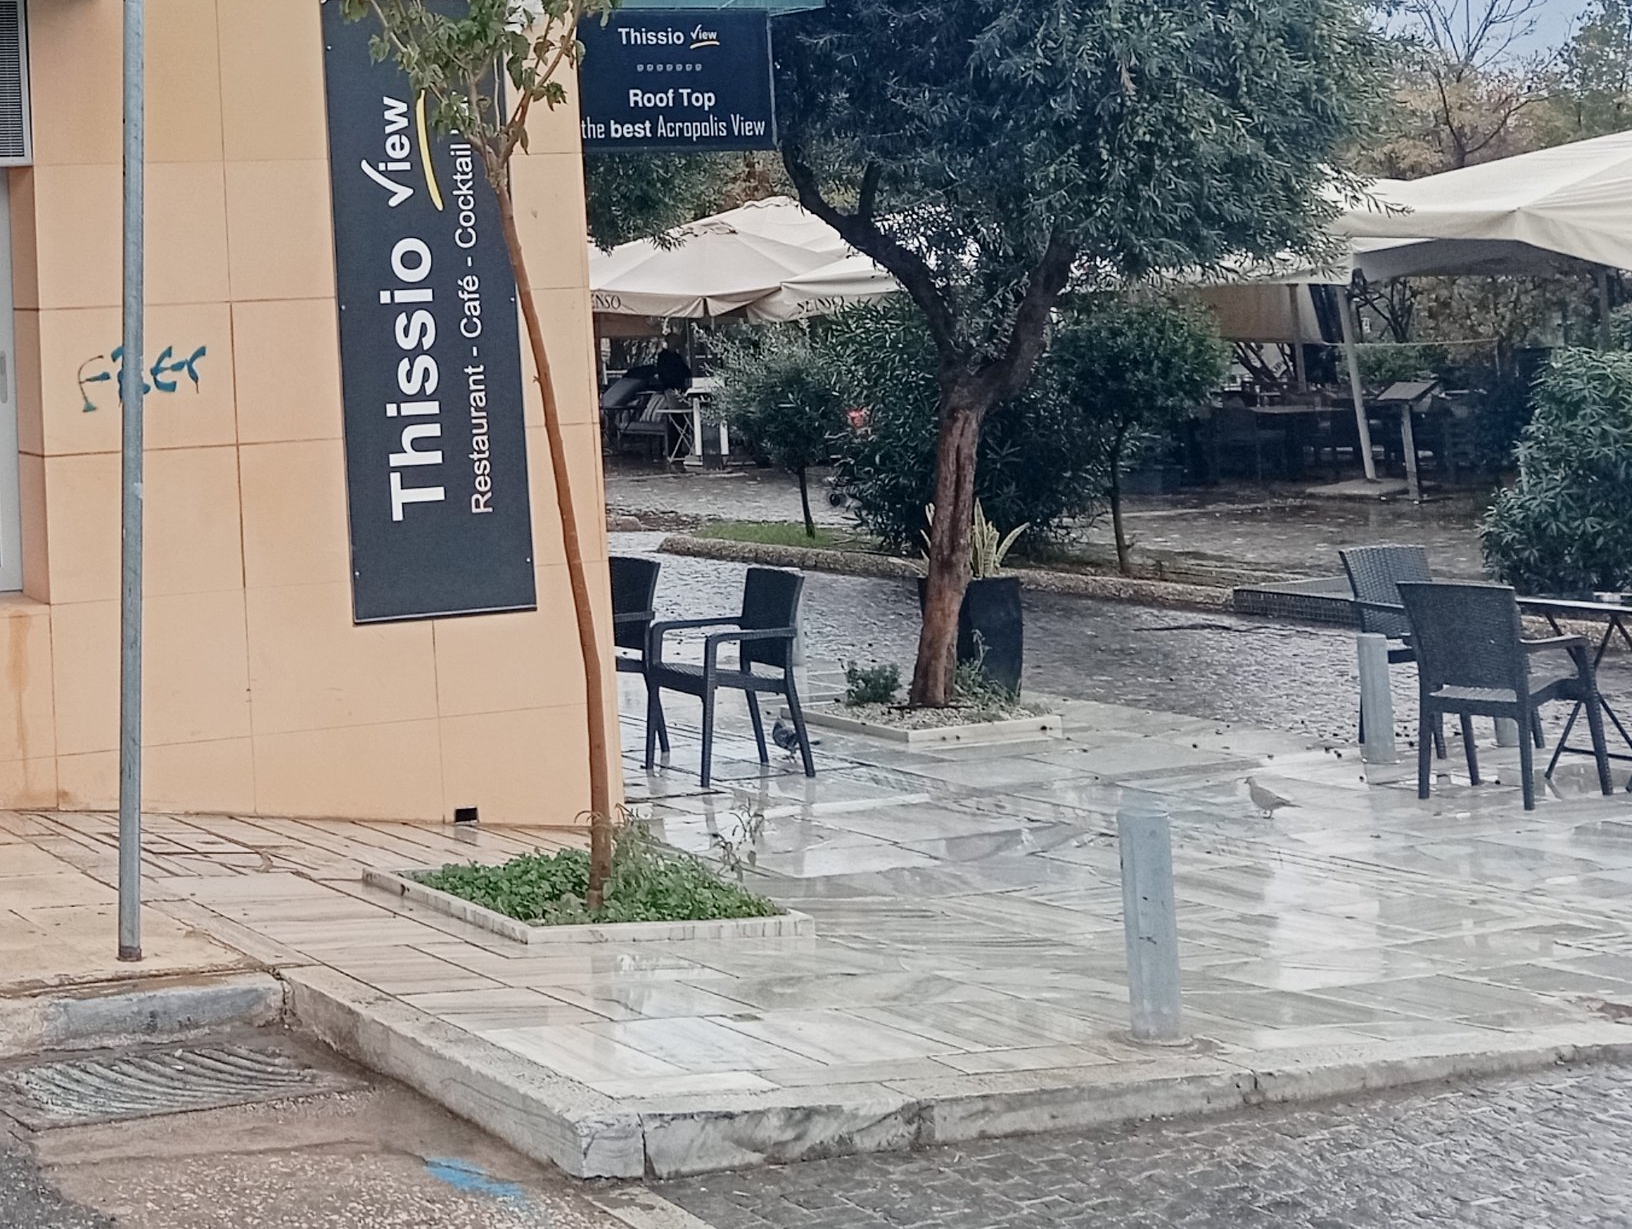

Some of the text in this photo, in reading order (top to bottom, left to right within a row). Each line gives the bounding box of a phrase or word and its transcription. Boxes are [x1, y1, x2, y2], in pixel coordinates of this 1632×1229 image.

[617, 27, 685, 45] Thissio
[581, 113, 766, 142] the best Acropolis View
[629, 88, 716, 111] Roof Top
[450, 143, 477, 249] Cocktail
[360, 96, 446, 522] Thissio View
[457, 275, 482, 338] Café
[469, 364, 493, 514] Restaurant
